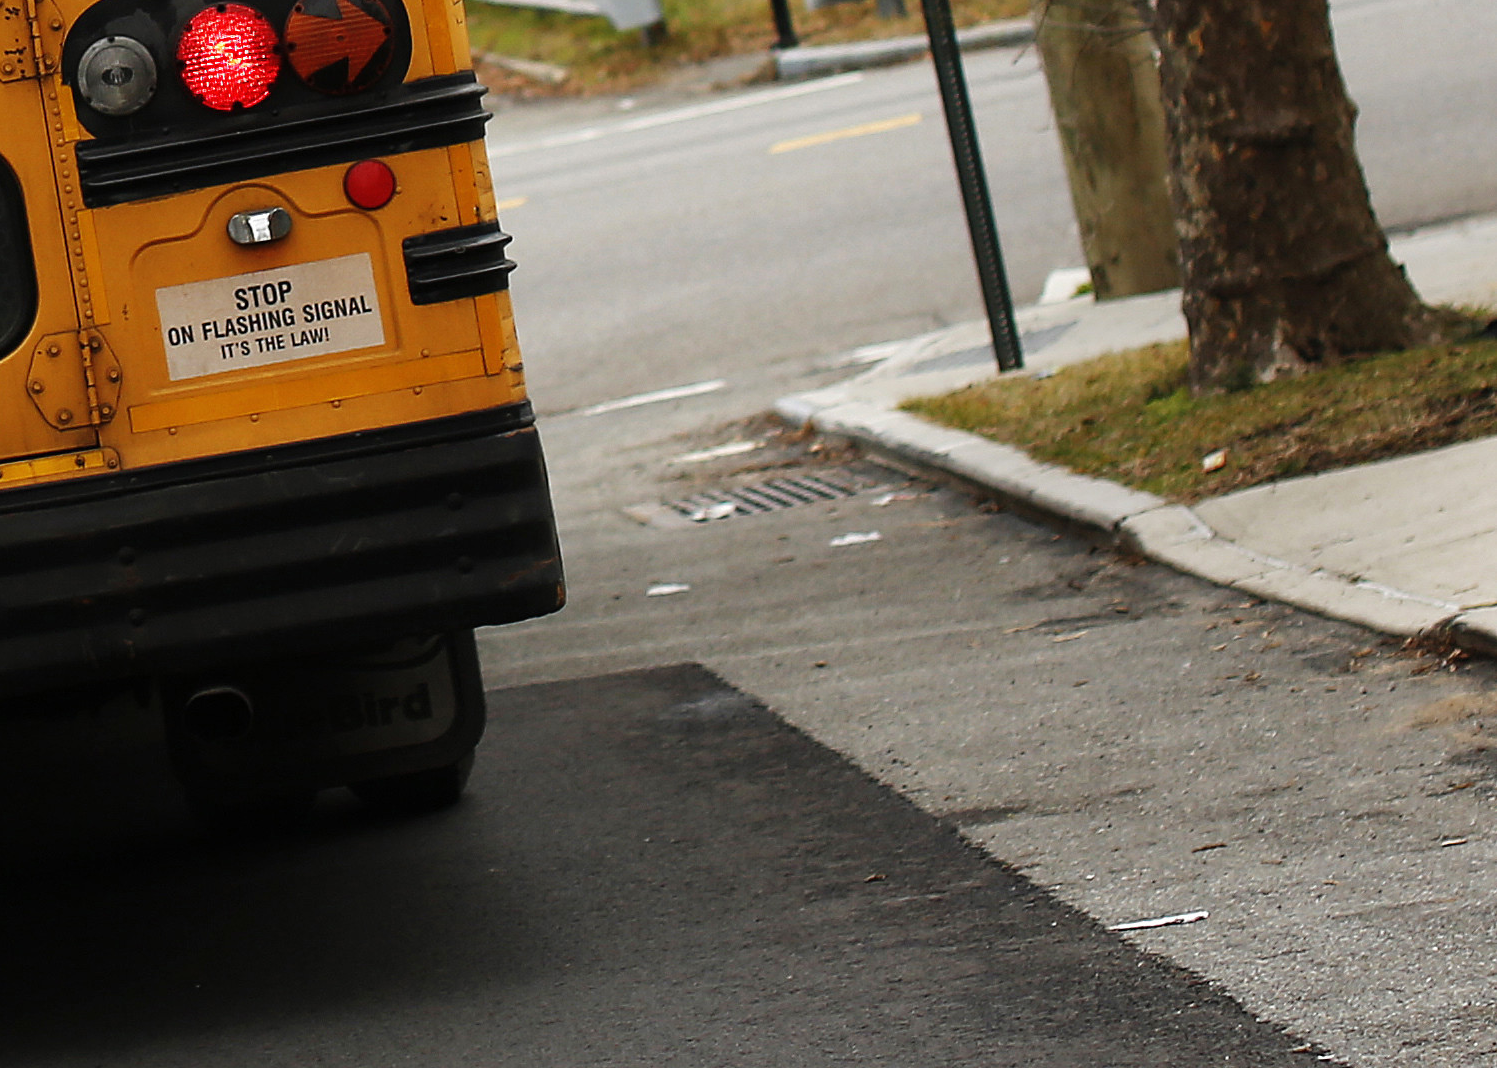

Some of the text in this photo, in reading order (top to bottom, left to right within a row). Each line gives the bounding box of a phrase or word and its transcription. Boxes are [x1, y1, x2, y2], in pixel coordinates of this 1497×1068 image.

[234, 280, 292, 310] STOP
[168, 295, 372, 347] ON FLASHING SIGNAL
[221, 327, 330, 360] IT'S THE LAW!
